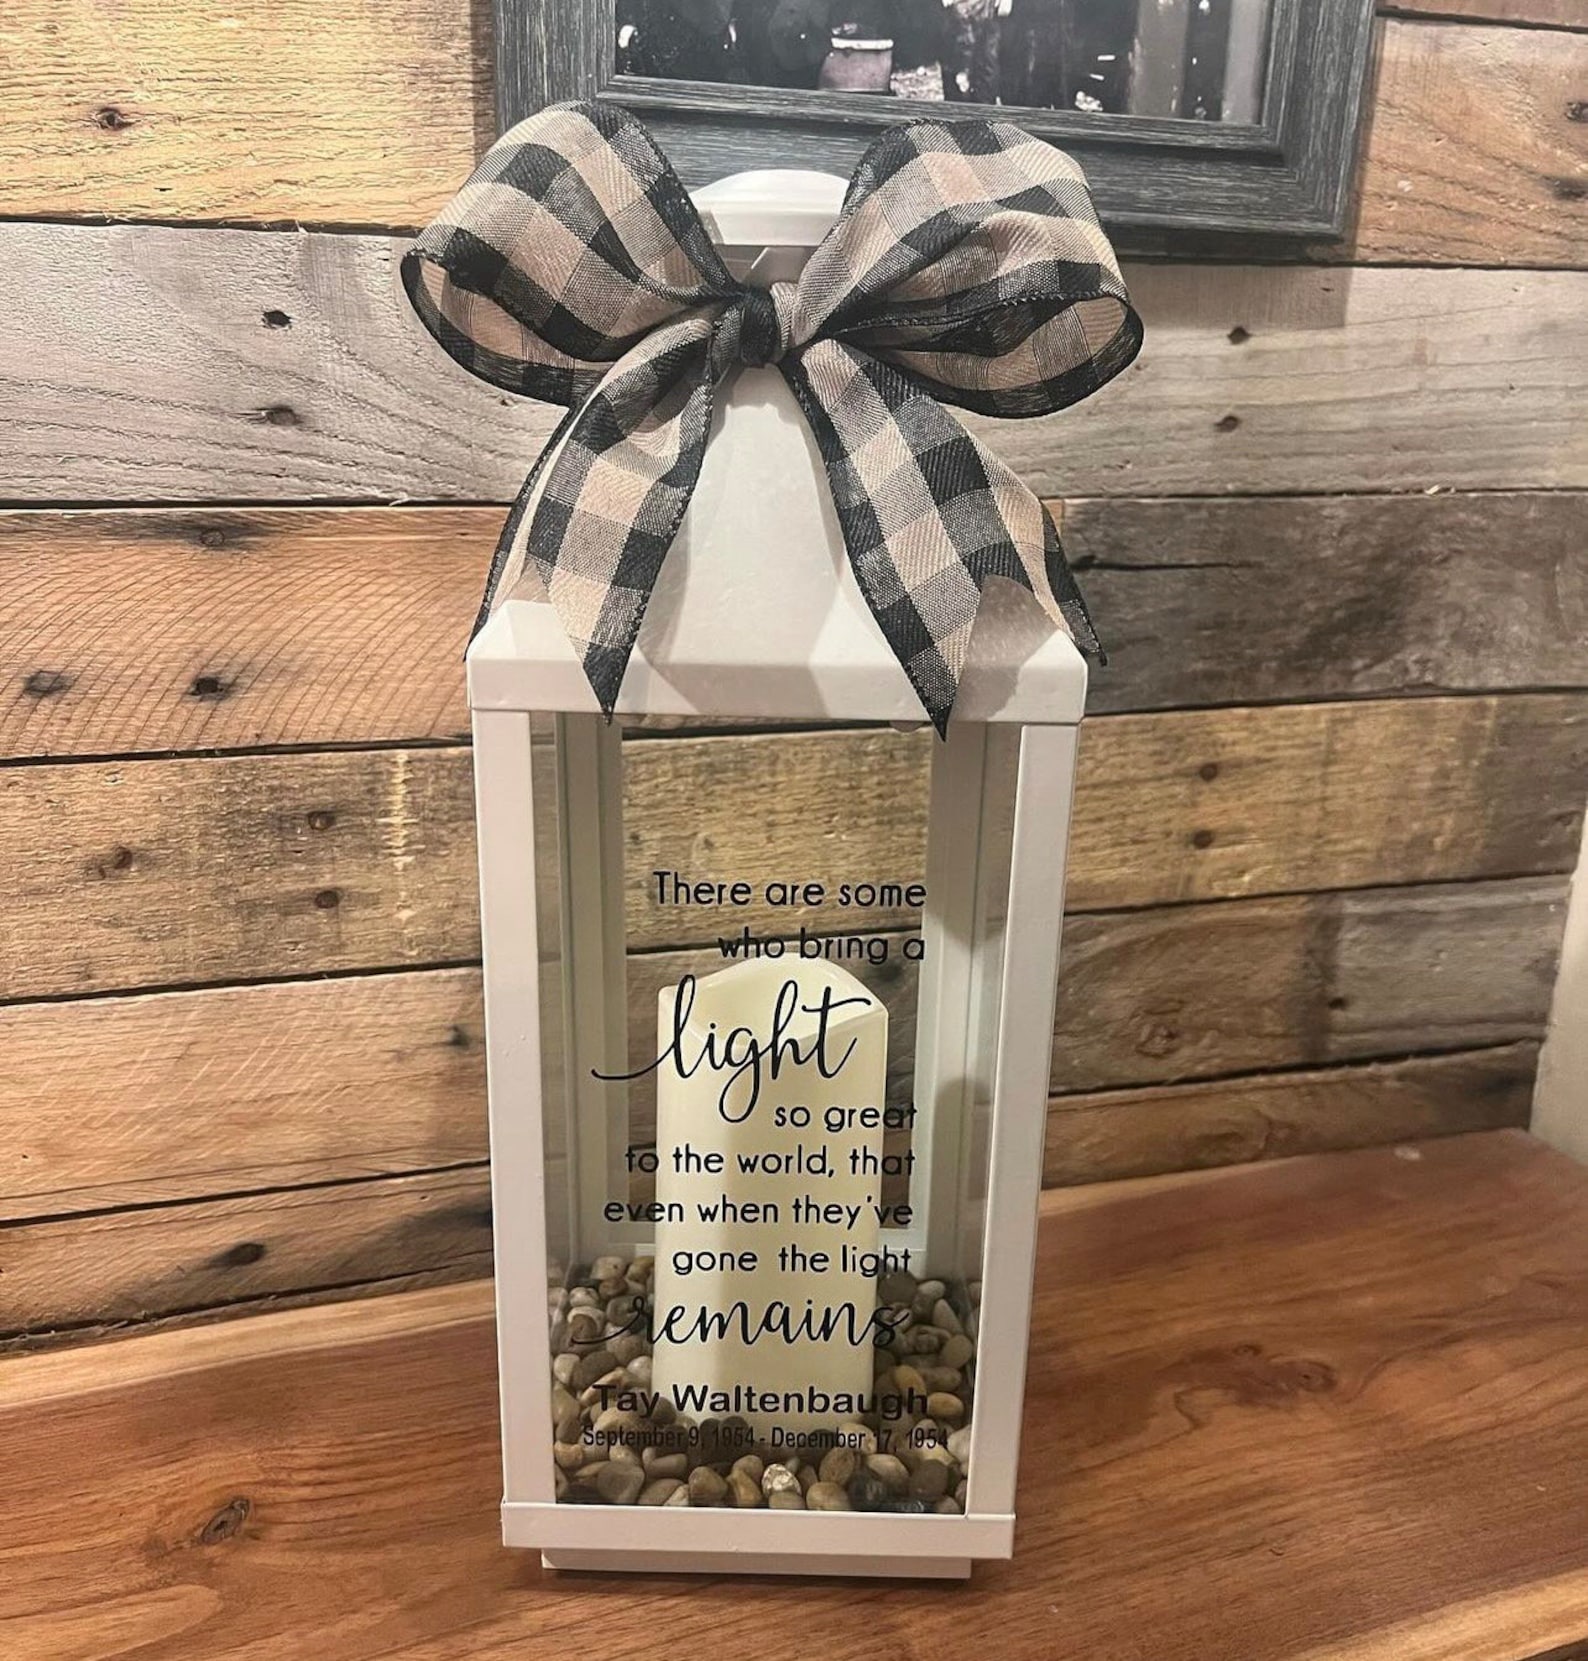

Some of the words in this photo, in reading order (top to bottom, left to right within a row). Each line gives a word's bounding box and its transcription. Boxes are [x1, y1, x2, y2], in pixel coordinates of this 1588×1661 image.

[653, 871, 752, 905] There
[765, 883, 825, 906] are
[838, 883, 927, 907] some
[718, 926, 785, 959] who
[800, 927, 889, 965] bring
[903, 939, 925, 960] a
[591, 974, 871, 1123] light
[774, 1107, 811, 1128] so
[824, 1107, 917, 1132] great
[625, 1146, 659, 1173] to
[673, 1145, 724, 1174] the
[737, 1144, 835, 1178] world,
[849, 1148, 916, 1175] that
[603, 1201, 684, 1223] even
[697, 1194, 779, 1224] when
[792, 1195, 913, 1230] they've
[672, 1250, 758, 1275] gone
[779, 1244, 828, 1273] the
[841, 1245, 912, 1277] light
[570, 1295, 910, 1347] remains
[592, 1384, 660, 1418] Tay
[672, 1384, 928, 1421] Waltenbaugh
[583, 1426, 684, 1449] September
[688, 1426, 705, 1448] 9,
[714, 1427, 755, 1448] 1954
[771, 1427, 866, 1449] December
[907, 1428, 948, 1449] 1954
